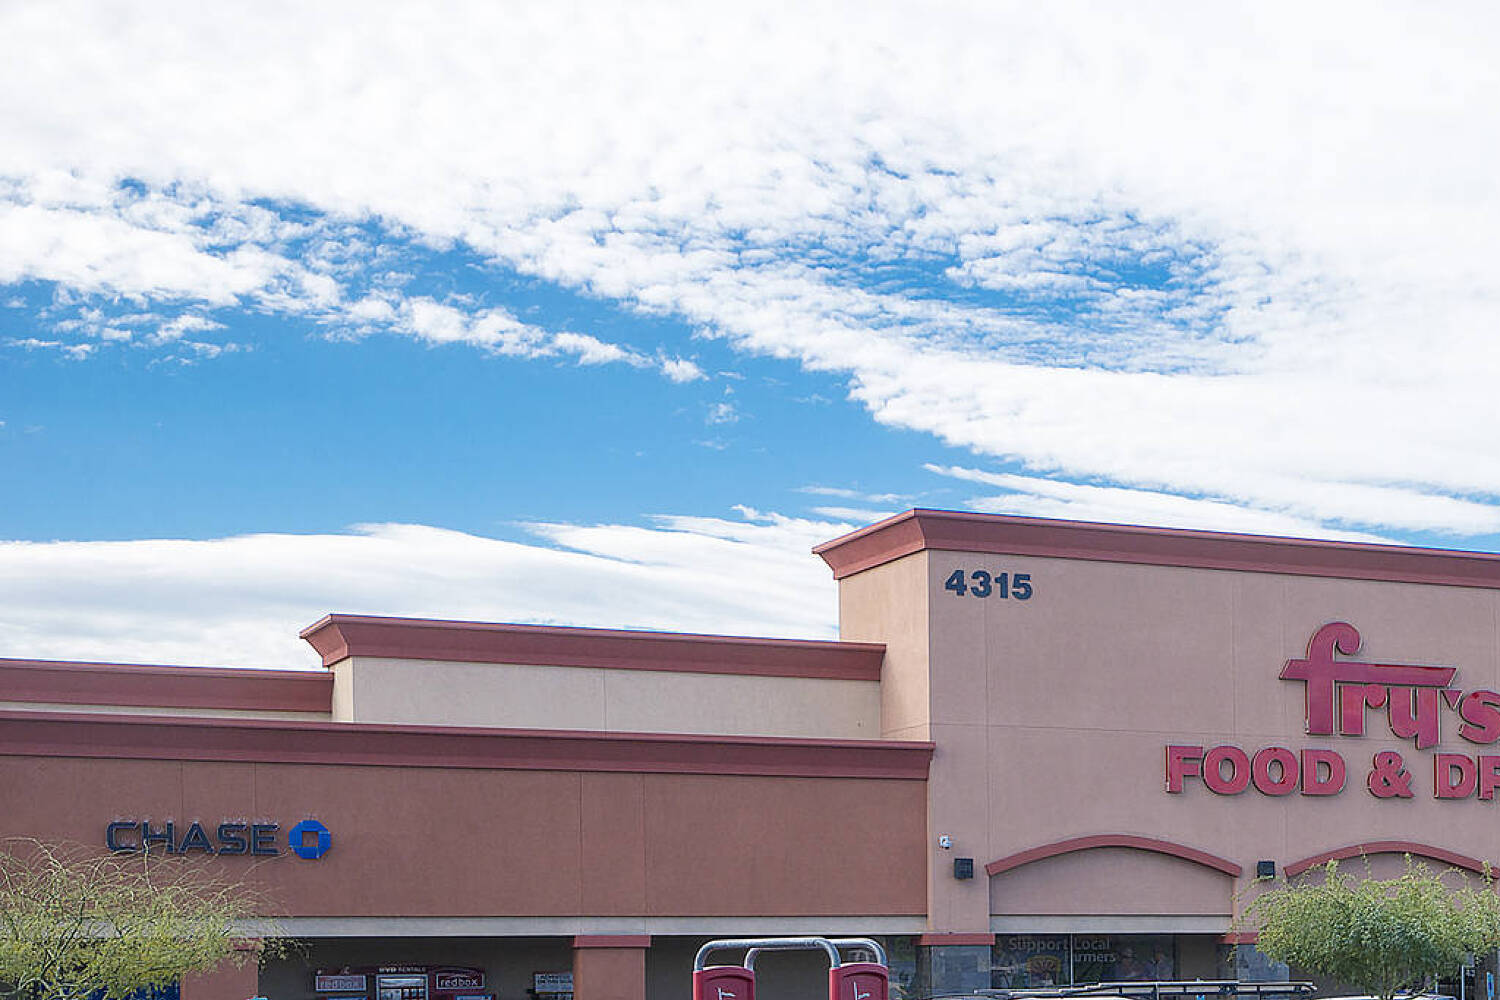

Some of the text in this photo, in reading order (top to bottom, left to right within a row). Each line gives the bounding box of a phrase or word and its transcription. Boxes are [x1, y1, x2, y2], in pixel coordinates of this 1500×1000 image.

[945, 569, 1033, 600] 4315
[1165, 745, 1347, 797] FOOD
[1366, 750, 1415, 799] &
[105, 819, 282, 856] CHASE
[1007, 936, 1111, 952] Support Local
[440, 975, 478, 987] redbox
